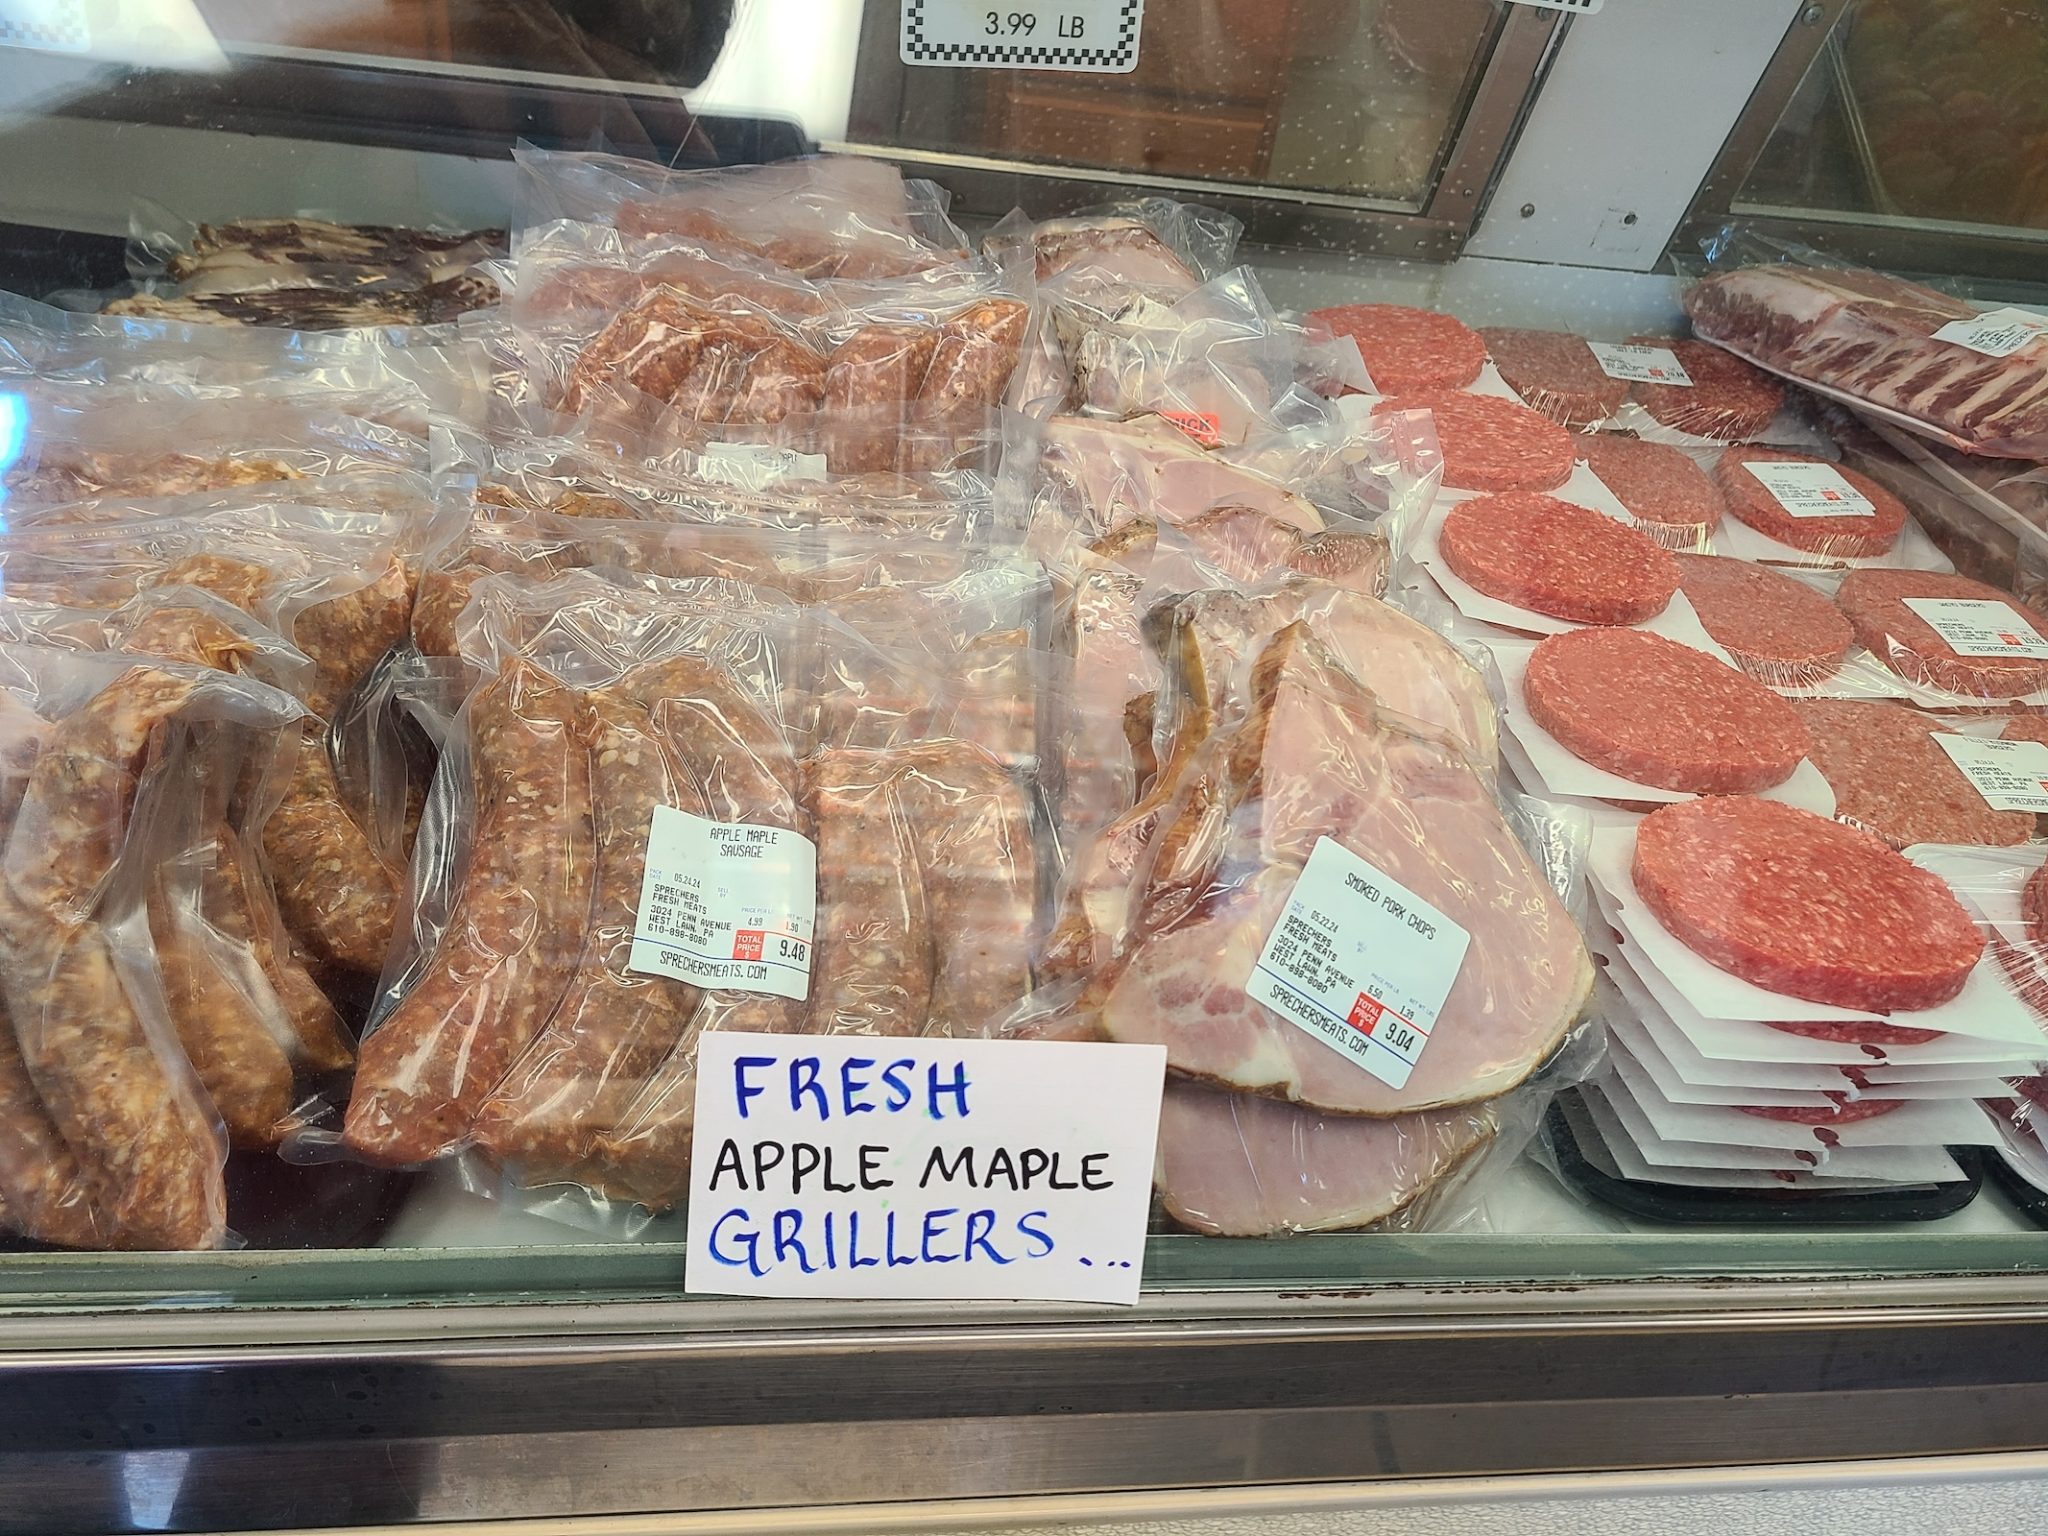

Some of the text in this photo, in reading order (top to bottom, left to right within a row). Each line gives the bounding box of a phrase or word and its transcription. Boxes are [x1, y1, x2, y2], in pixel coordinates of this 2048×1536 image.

[985, 11, 1085, 39] 3.99 LB
[710, 828, 779, 845] APPLE MAPLE
[720, 845, 764, 859] SAUSAGE
[652, 892, 708, 915] FRESH MEATS
[654, 883, 700, 903] SPRECHERS
[650, 904, 732, 931] 3024 PENN AVENUE
[1344, 872, 1437, 941] SMOKED PORK CHOPS
[647, 923, 708, 946] 610-898-8080
[649, 914, 671, 926] WEST
[703, 928, 714, 938] PA
[1287, 914, 1333, 948] SPRECHERS
[737, 935, 762, 944] TOTAL
[737, 943, 761, 952] PRICE
[779, 939, 806, 962] 9.48
[1283, 922, 1310, 945] FRESH
[1311, 941, 1338, 962] MEATS
[1270, 951, 1328, 994] 610-898-8080
[1273, 943, 1295, 961] WEST
[1325, 976, 1337, 989] PA
[1277, 934, 1355, 989] 3024 PENN AVENUE
[1354, 1006, 1376, 1025] PRICE
[1358, 998, 1380, 1018] TOTAL
[1385, 1022, 1415, 1052] 9.04
[733, 1056, 972, 1121] FRESH
[709, 1138, 1115, 1195] APPLE MAPLE
